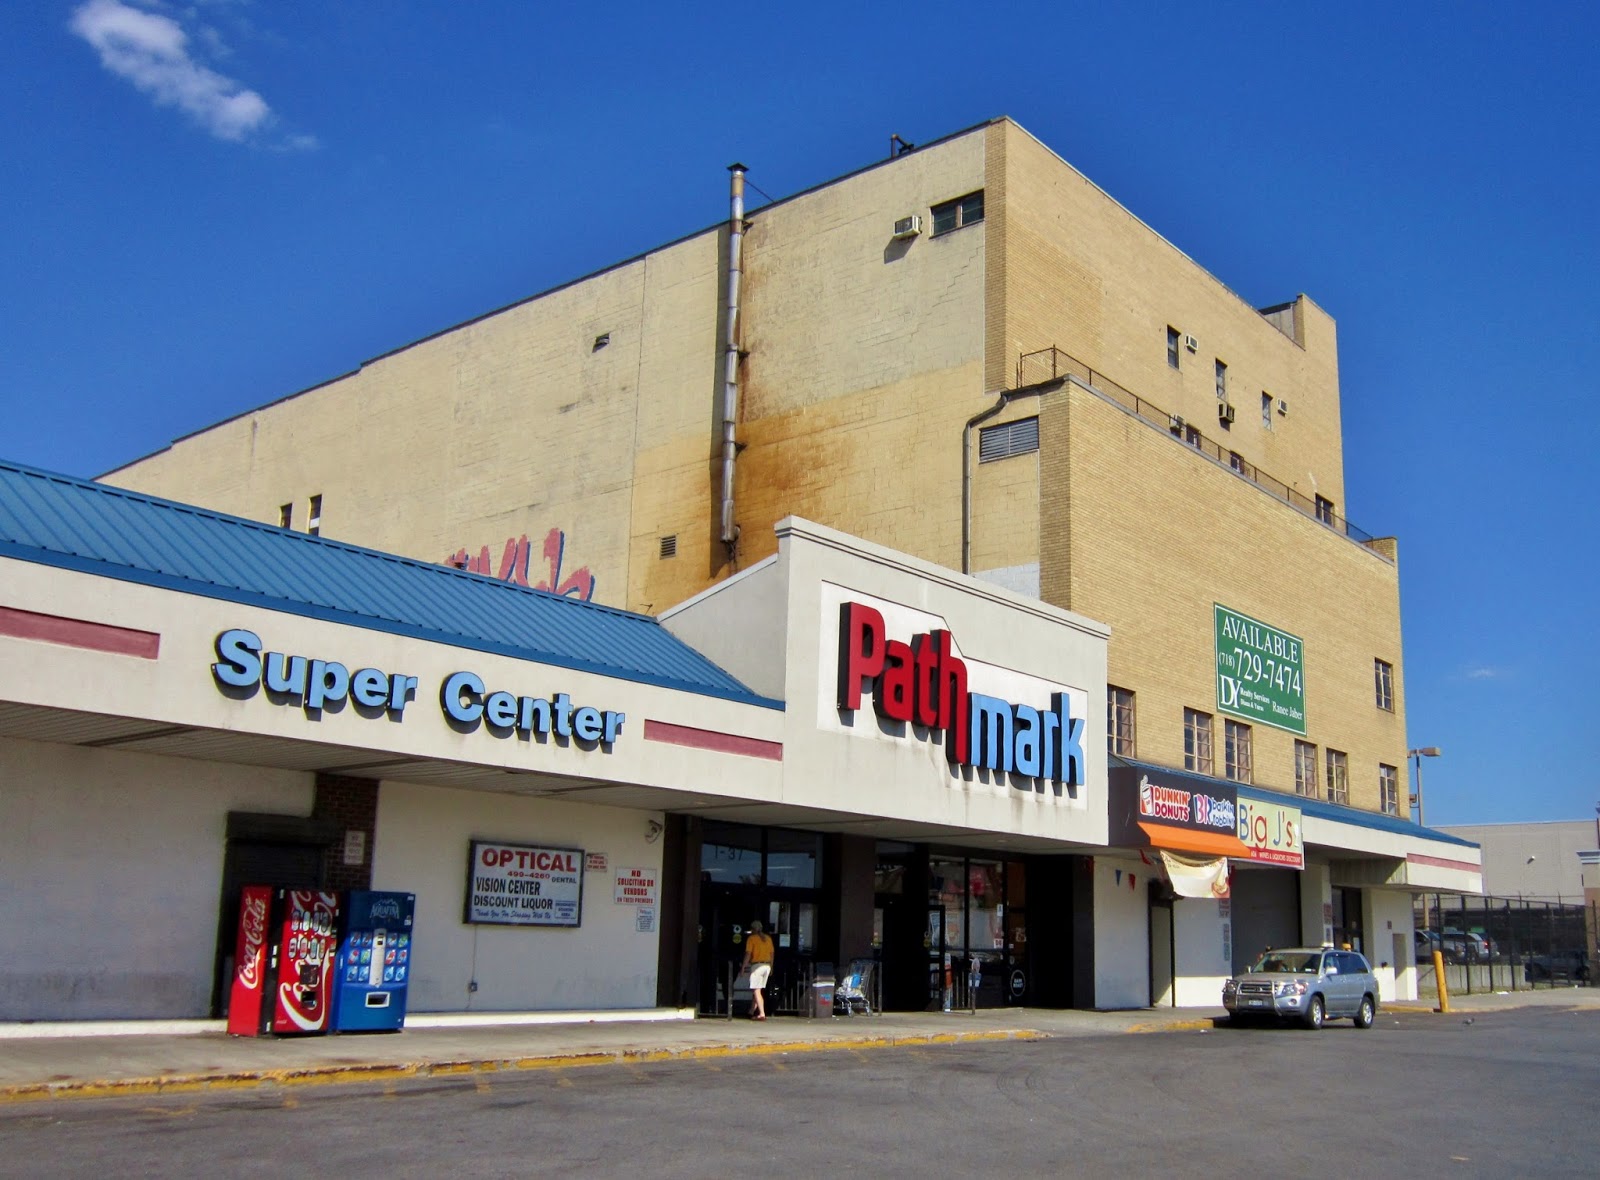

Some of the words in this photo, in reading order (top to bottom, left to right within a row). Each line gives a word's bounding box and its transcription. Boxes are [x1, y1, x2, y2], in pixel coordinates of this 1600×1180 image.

[1222, 615, 1299, 664] AVAILABLE
[1218, 651, 1235, 670] (718)
[1233, 646, 1302, 698] 729-7474
[213, 628, 418, 711] Super
[441, 671, 625, 743] Center
[838, 601, 1084, 785] Pathmark
[1219, 674, 1242, 709] DY
[1253, 691, 1271, 704] Services
[1153, 786, 1191, 806] DUNKIN'
[1153, 801, 1190, 822] DONUTS
[1239, 804, 1268, 853] Big
[1273, 810, 1293, 848] J's
[482, 848, 577, 872] OPTICAL
[507, 871, 551, 880] 499-4260
[551, 876, 577, 884] DENTAL
[617, 877, 646, 887] SOLICITING
[646, 879, 654, 887] OR
[631, 869, 641, 878] NO
[476, 877, 506, 893] VISION
[508, 880, 541, 896] CENTER
[623, 887, 648, 896] VENDORS
[474, 895, 520, 908] DISCOUNT
[521, 898, 554, 910] LIQUOR
